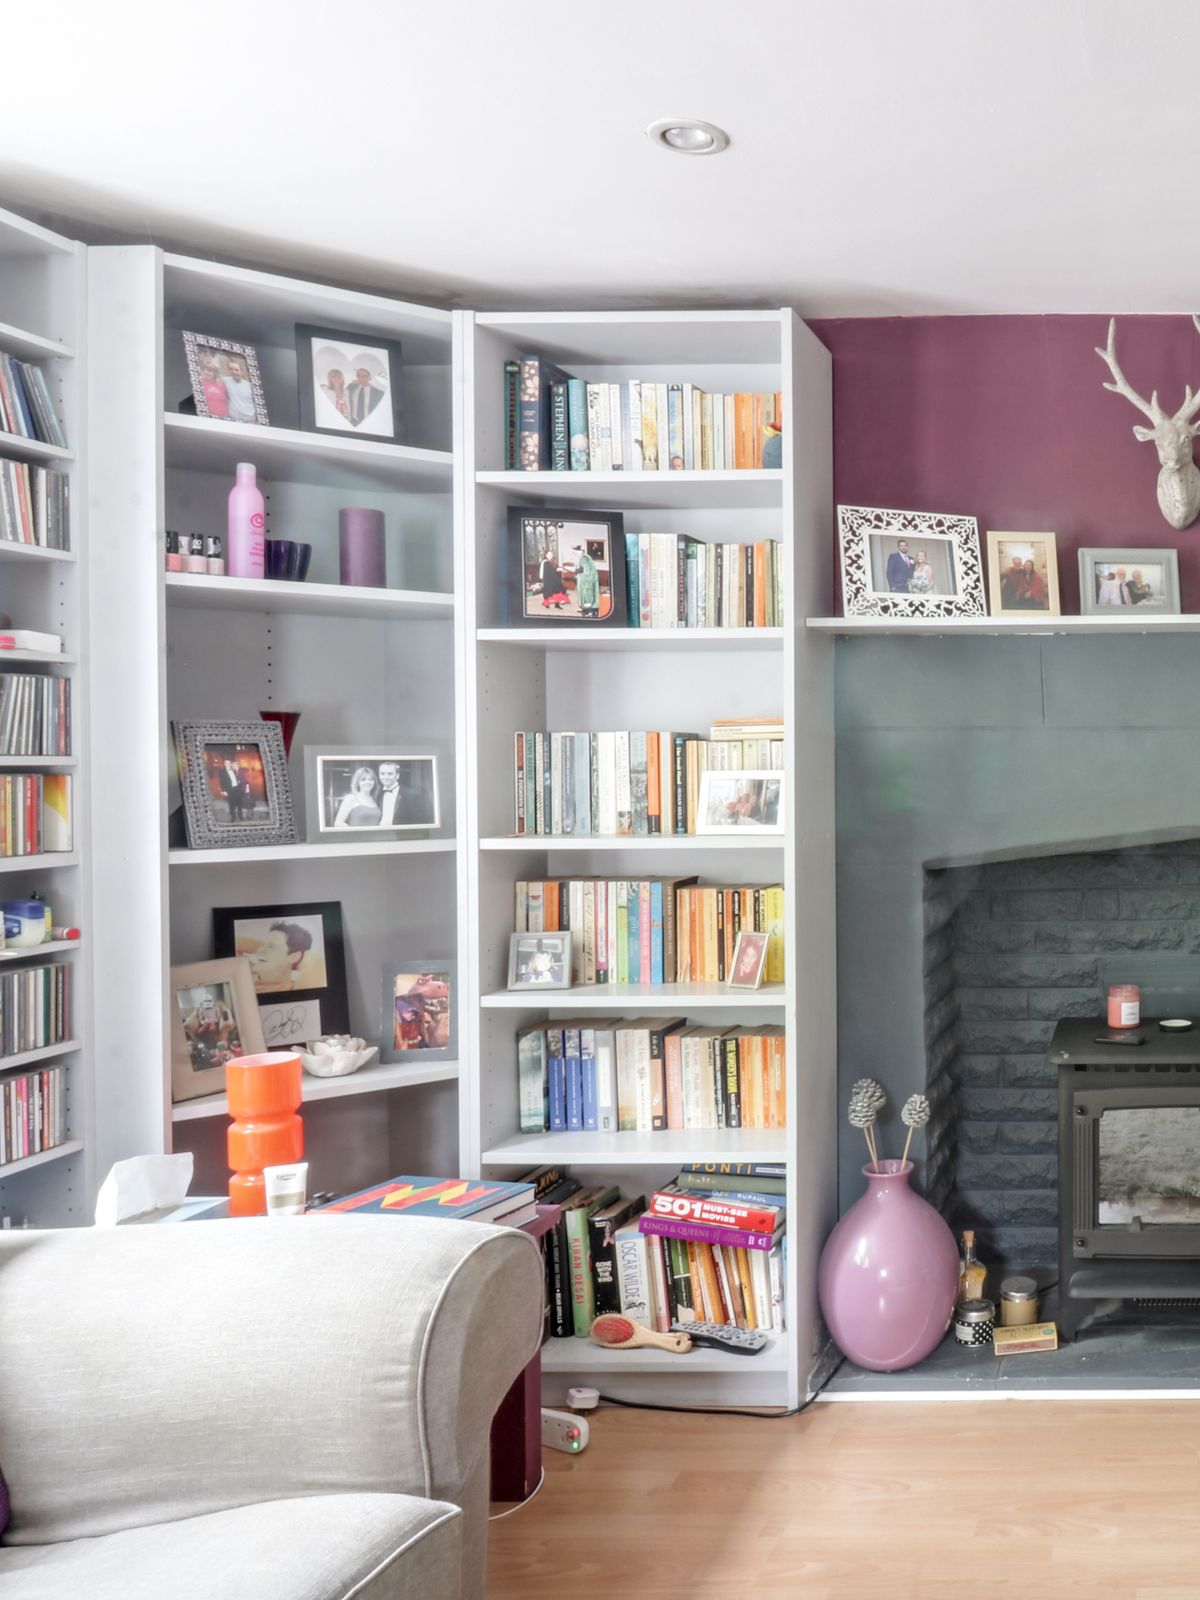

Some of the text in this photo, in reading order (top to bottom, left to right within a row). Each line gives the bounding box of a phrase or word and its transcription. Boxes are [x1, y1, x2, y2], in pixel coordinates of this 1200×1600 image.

[555, 395, 565, 441] STEPHEN
[726, 1040, 737, 1094] THE WOMEN'S ROOM
[691, 1163, 752, 1175] PONTI
[654, 1194, 703, 1219] 501
[736, 1193, 767, 1203] RUPAUL
[701, 1212, 736, 1223] MOVIES
[702, 1204, 749, 1218] MUST-SEE
[643, 1221, 668, 1231] KINGS
[678, 1225, 710, 1238] QUEENS
[571, 1237, 584, 1304] KIRAN DESAI
[620, 1241, 640, 1300] OSCAR WILDE
